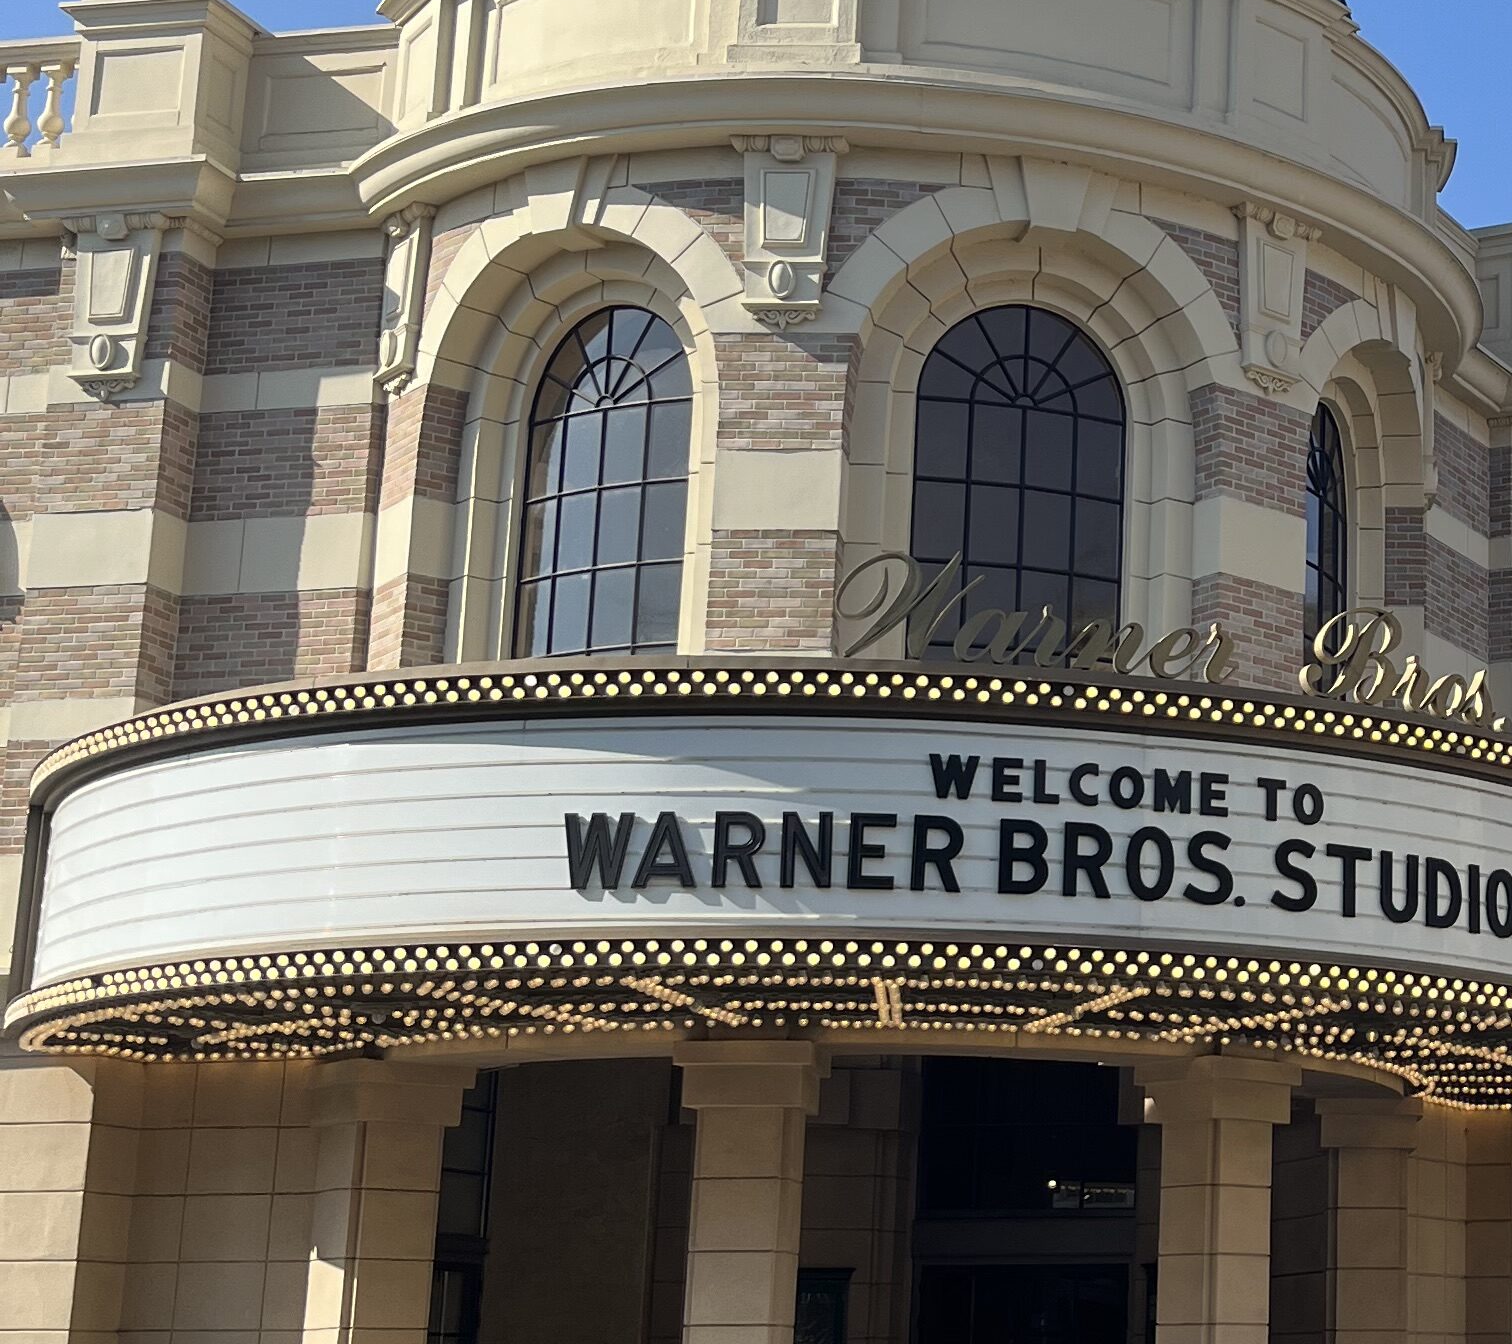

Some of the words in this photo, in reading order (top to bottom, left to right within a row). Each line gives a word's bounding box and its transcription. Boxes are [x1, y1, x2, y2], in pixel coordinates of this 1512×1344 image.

[836, 550, 1240, 684] Warner
[1298, 607, 1510, 733] Bros.
[928, 753, 1230, 818] WELCOME
[1256, 777, 1325, 826] TO
[564, 811, 965, 894] WARNER
[997, 818, 1246, 908] BROS.
